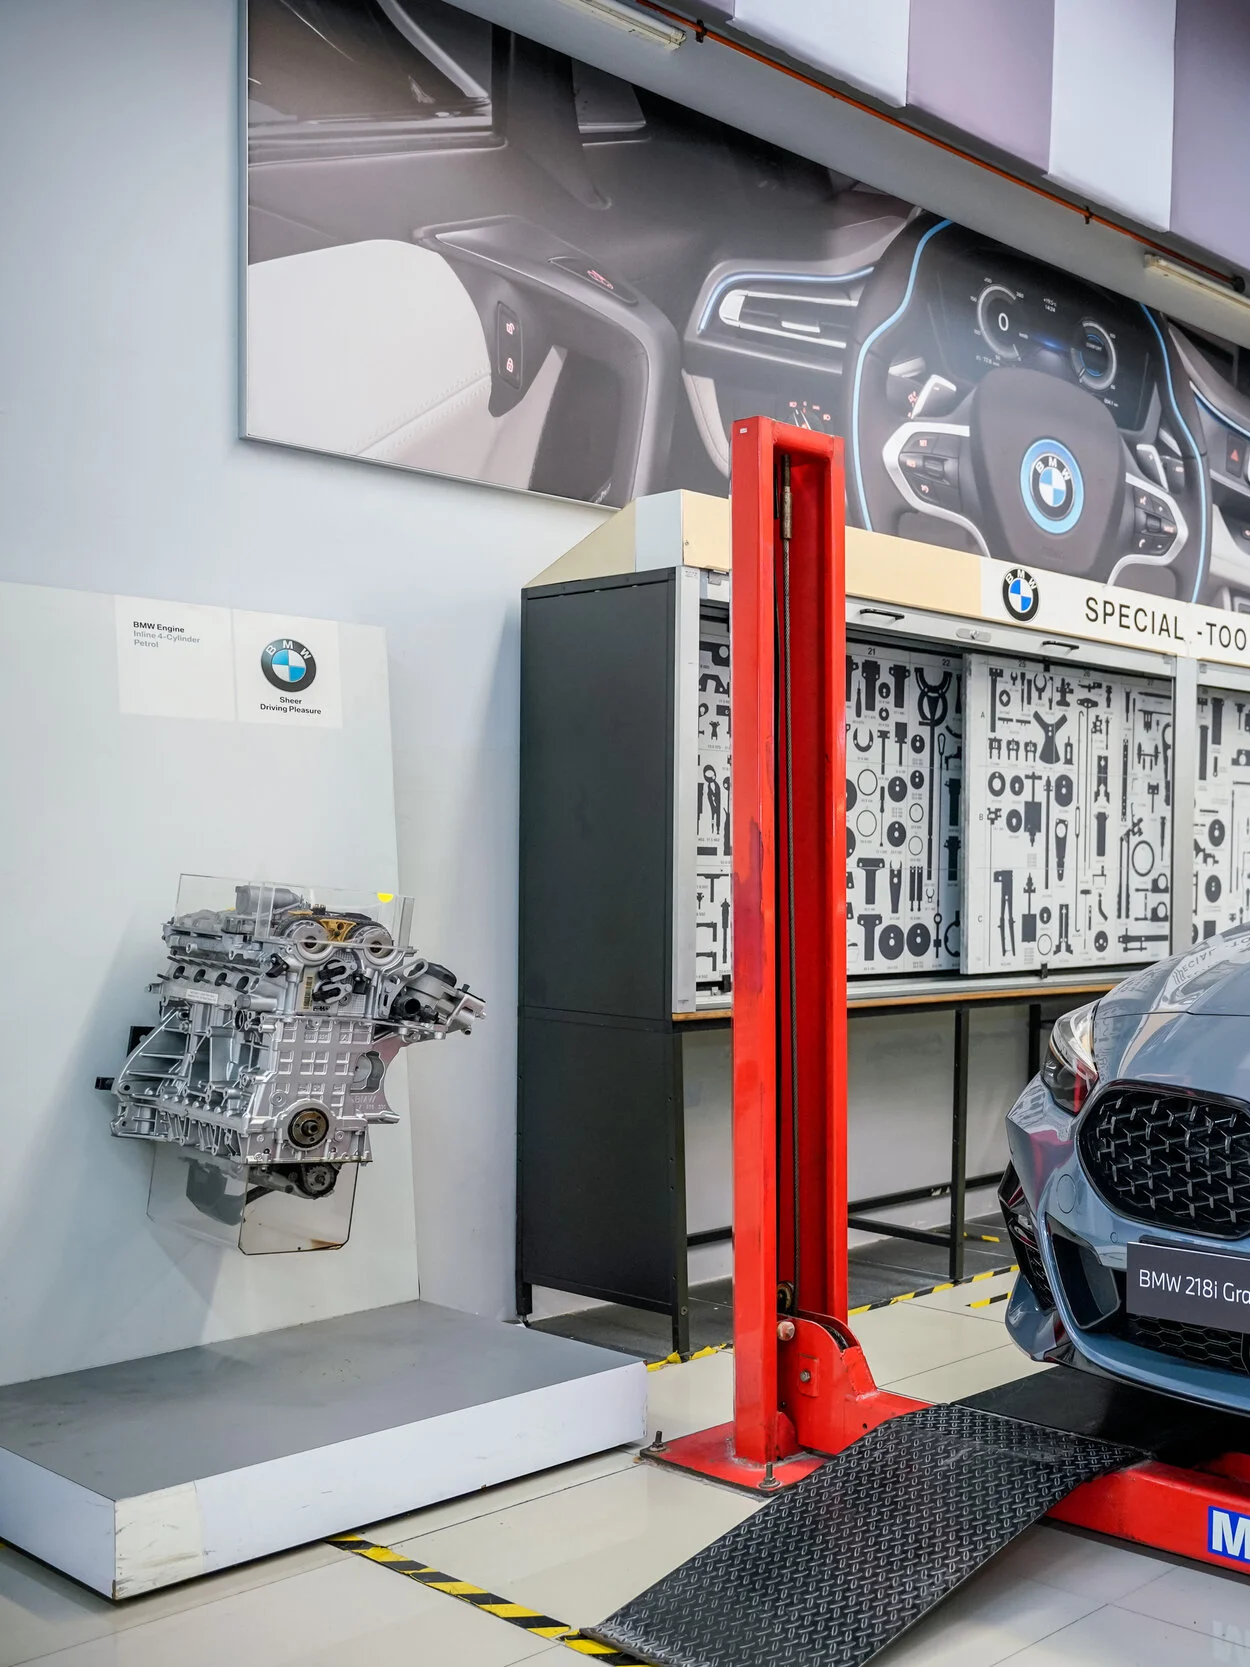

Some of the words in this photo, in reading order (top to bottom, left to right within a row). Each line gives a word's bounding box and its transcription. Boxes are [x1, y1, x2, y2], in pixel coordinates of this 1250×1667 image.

[1085, 596, 1185, 641] SPECIAL
[132, 620, 156, 630] BMW
[156, 623, 185, 634] Engine
[133, 630, 156, 639] Inline
[157, 632, 200, 644] 4-Cylinder
[134, 638, 159, 648] Petrol
[867, 647, 876, 656] 21
[941, 658, 951, 667] 22
[279, 696, 302, 705] Sheer
[260, 703, 288, 713] Driving
[288, 705, 322, 715] Pleasure
[1138, 1269, 1182, 1293] BMW
[1185, 1276, 1218, 1299] 218i
